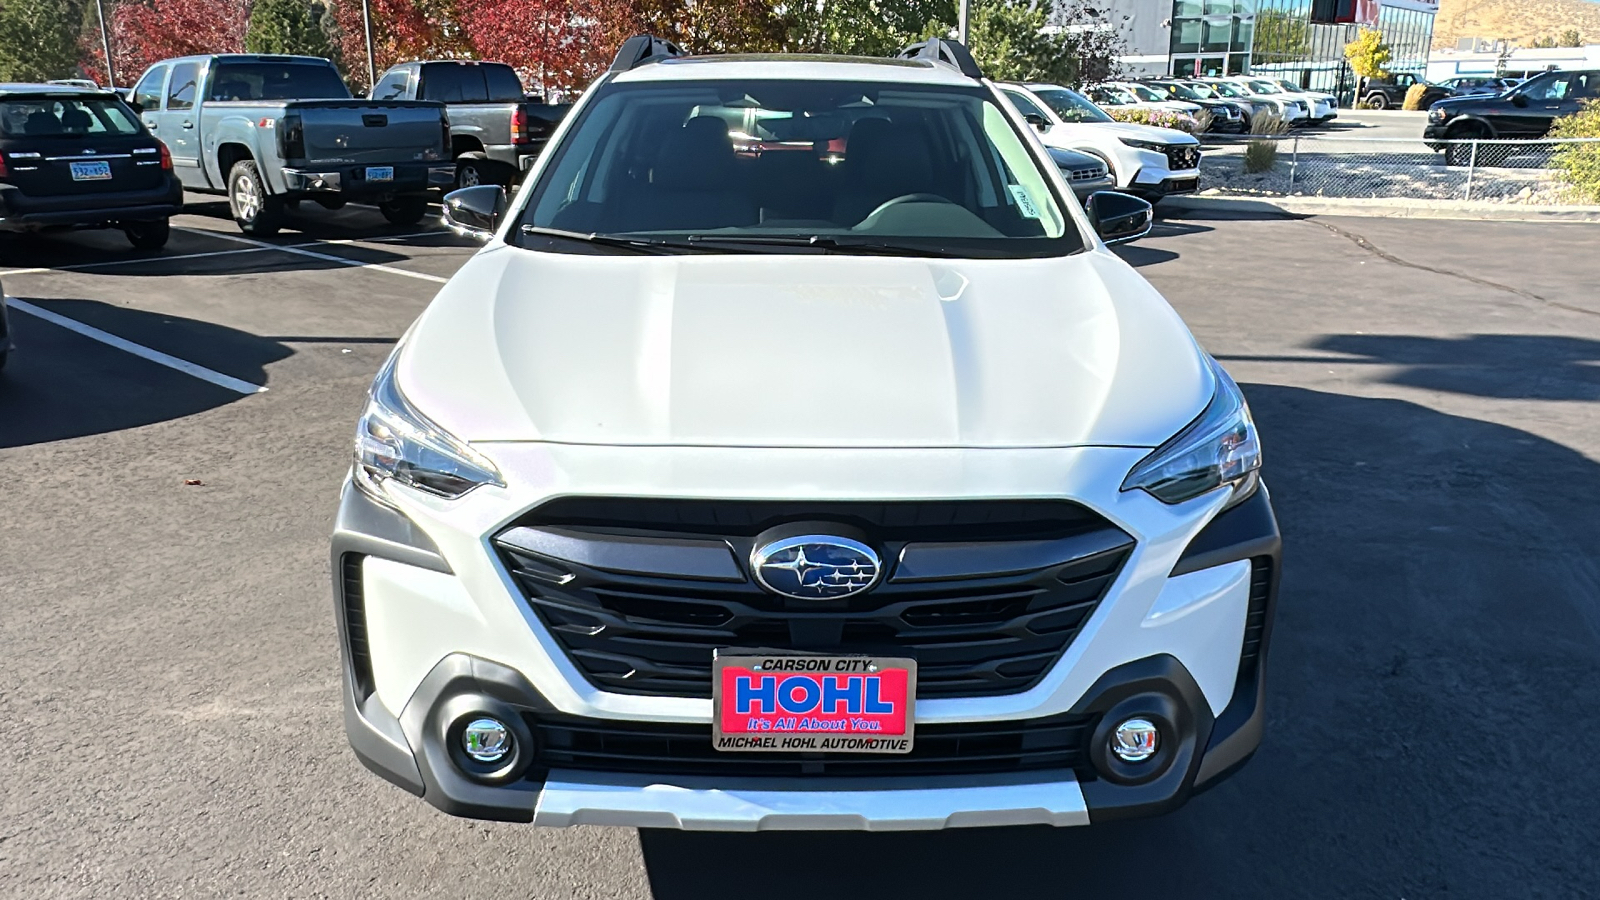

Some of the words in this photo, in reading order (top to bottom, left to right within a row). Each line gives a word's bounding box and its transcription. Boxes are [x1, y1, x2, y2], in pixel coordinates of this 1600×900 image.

[762, 659, 831, 671] CARSON
[835, 660, 873, 671] CITY
[735, 676, 894, 714] HOHL
[747, 718, 771, 730] It's
[774, 718, 795, 730] All
[797, 718, 846, 731] About
[850, 718, 882, 731] You.
[718, 737, 777, 748] MICHAEL
[781, 737, 818, 749] HOHL
[820, 737, 909, 750] AUTOMOTIVE
